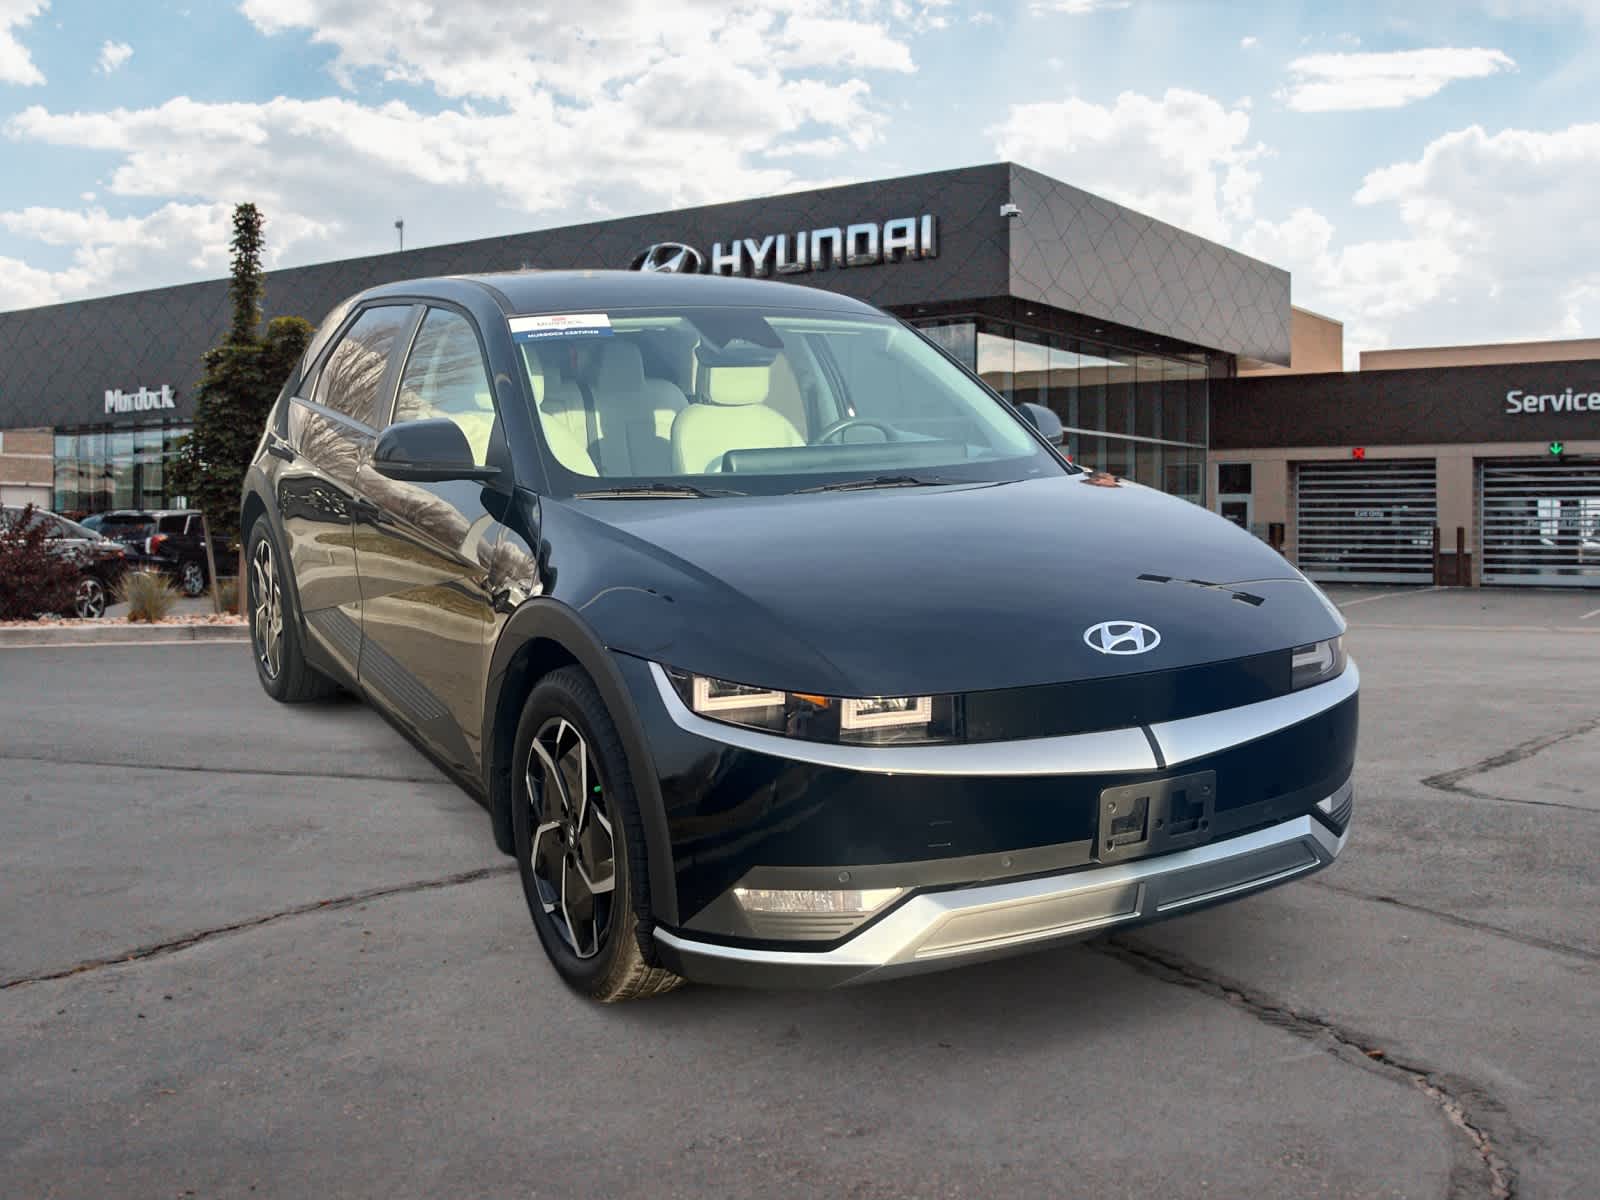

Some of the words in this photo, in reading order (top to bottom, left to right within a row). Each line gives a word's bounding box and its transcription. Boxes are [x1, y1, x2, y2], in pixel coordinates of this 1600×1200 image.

[711, 214, 938, 276] HYUNDAI
[104, 384, 176, 414] Murdock
[1505, 387, 1600, 414] Service
